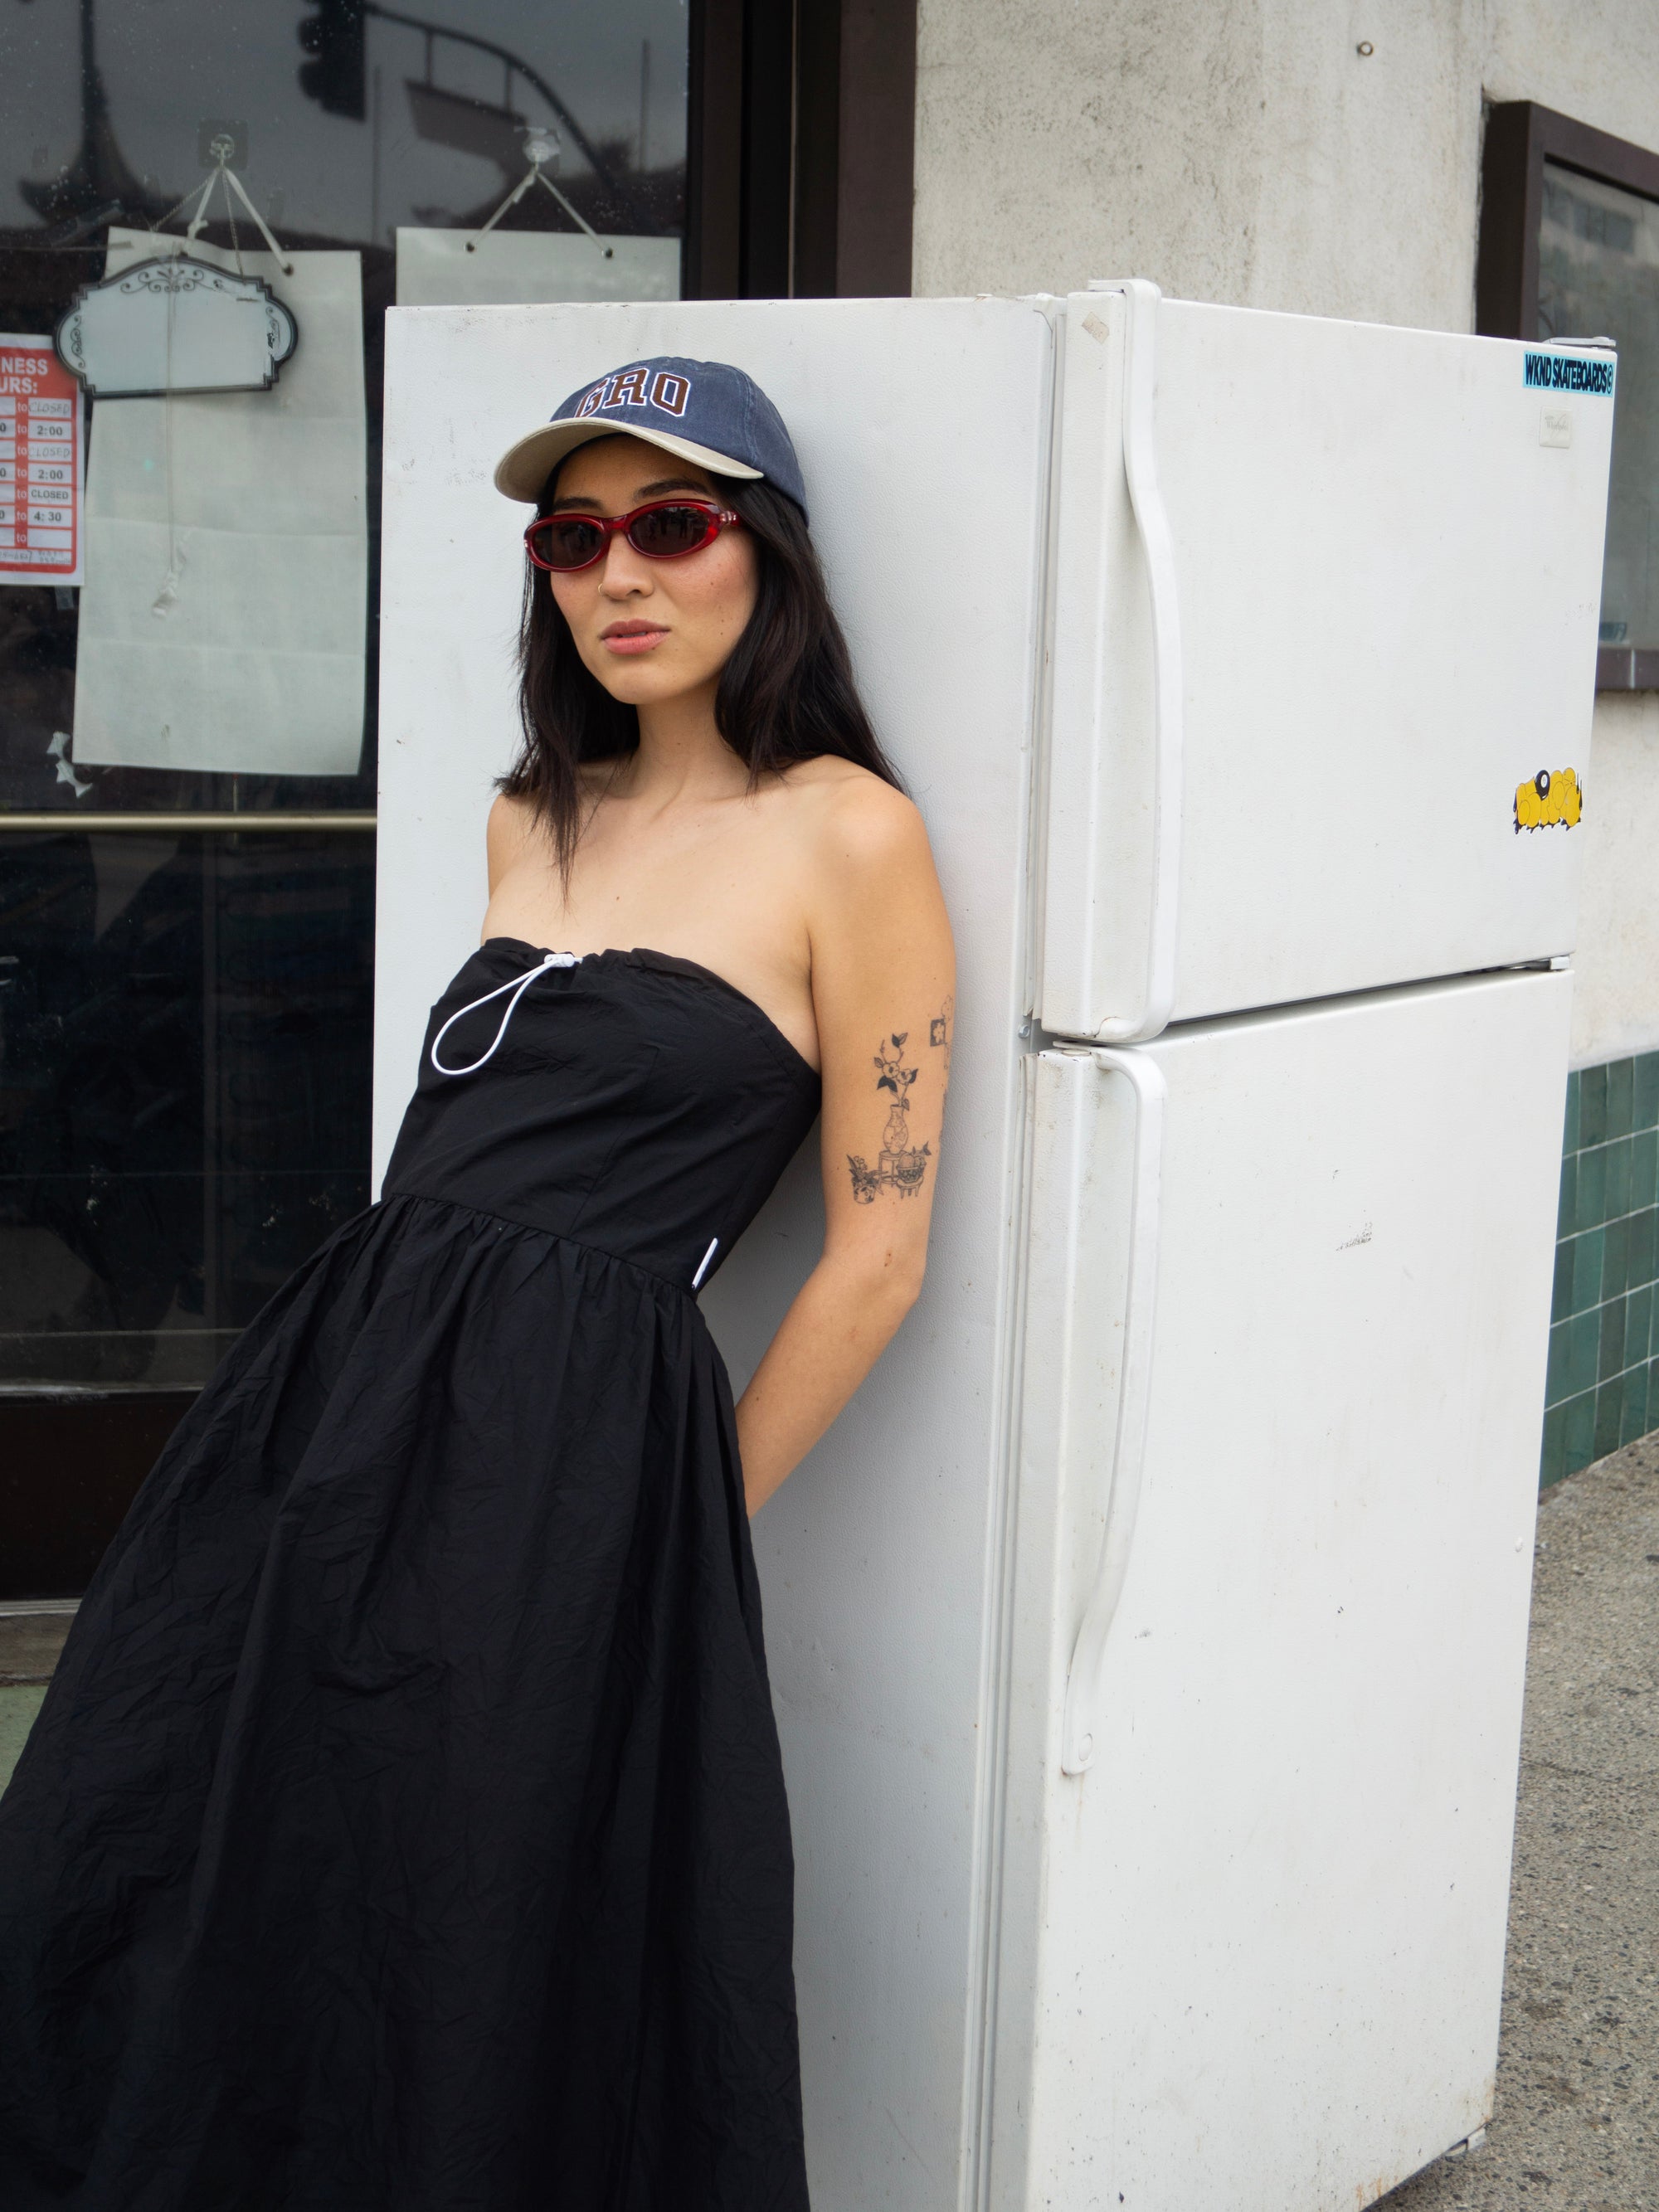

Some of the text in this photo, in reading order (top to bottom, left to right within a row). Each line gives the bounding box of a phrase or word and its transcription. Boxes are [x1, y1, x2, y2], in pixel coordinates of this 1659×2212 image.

[1525, 354, 1552, 387] WKND
[575, 367, 691, 417] GRO
[17, 401, 27, 413] to
[17, 424, 27, 435] to
[37, 425, 63, 436] 2:00
[17, 445, 27, 456] to
[17, 468, 27, 479] to
[38, 469, 63, 480] 2:00
[17, 489, 69, 499] to CLOSED
[17, 511, 27, 522] to
[17, 533, 27, 544] to
